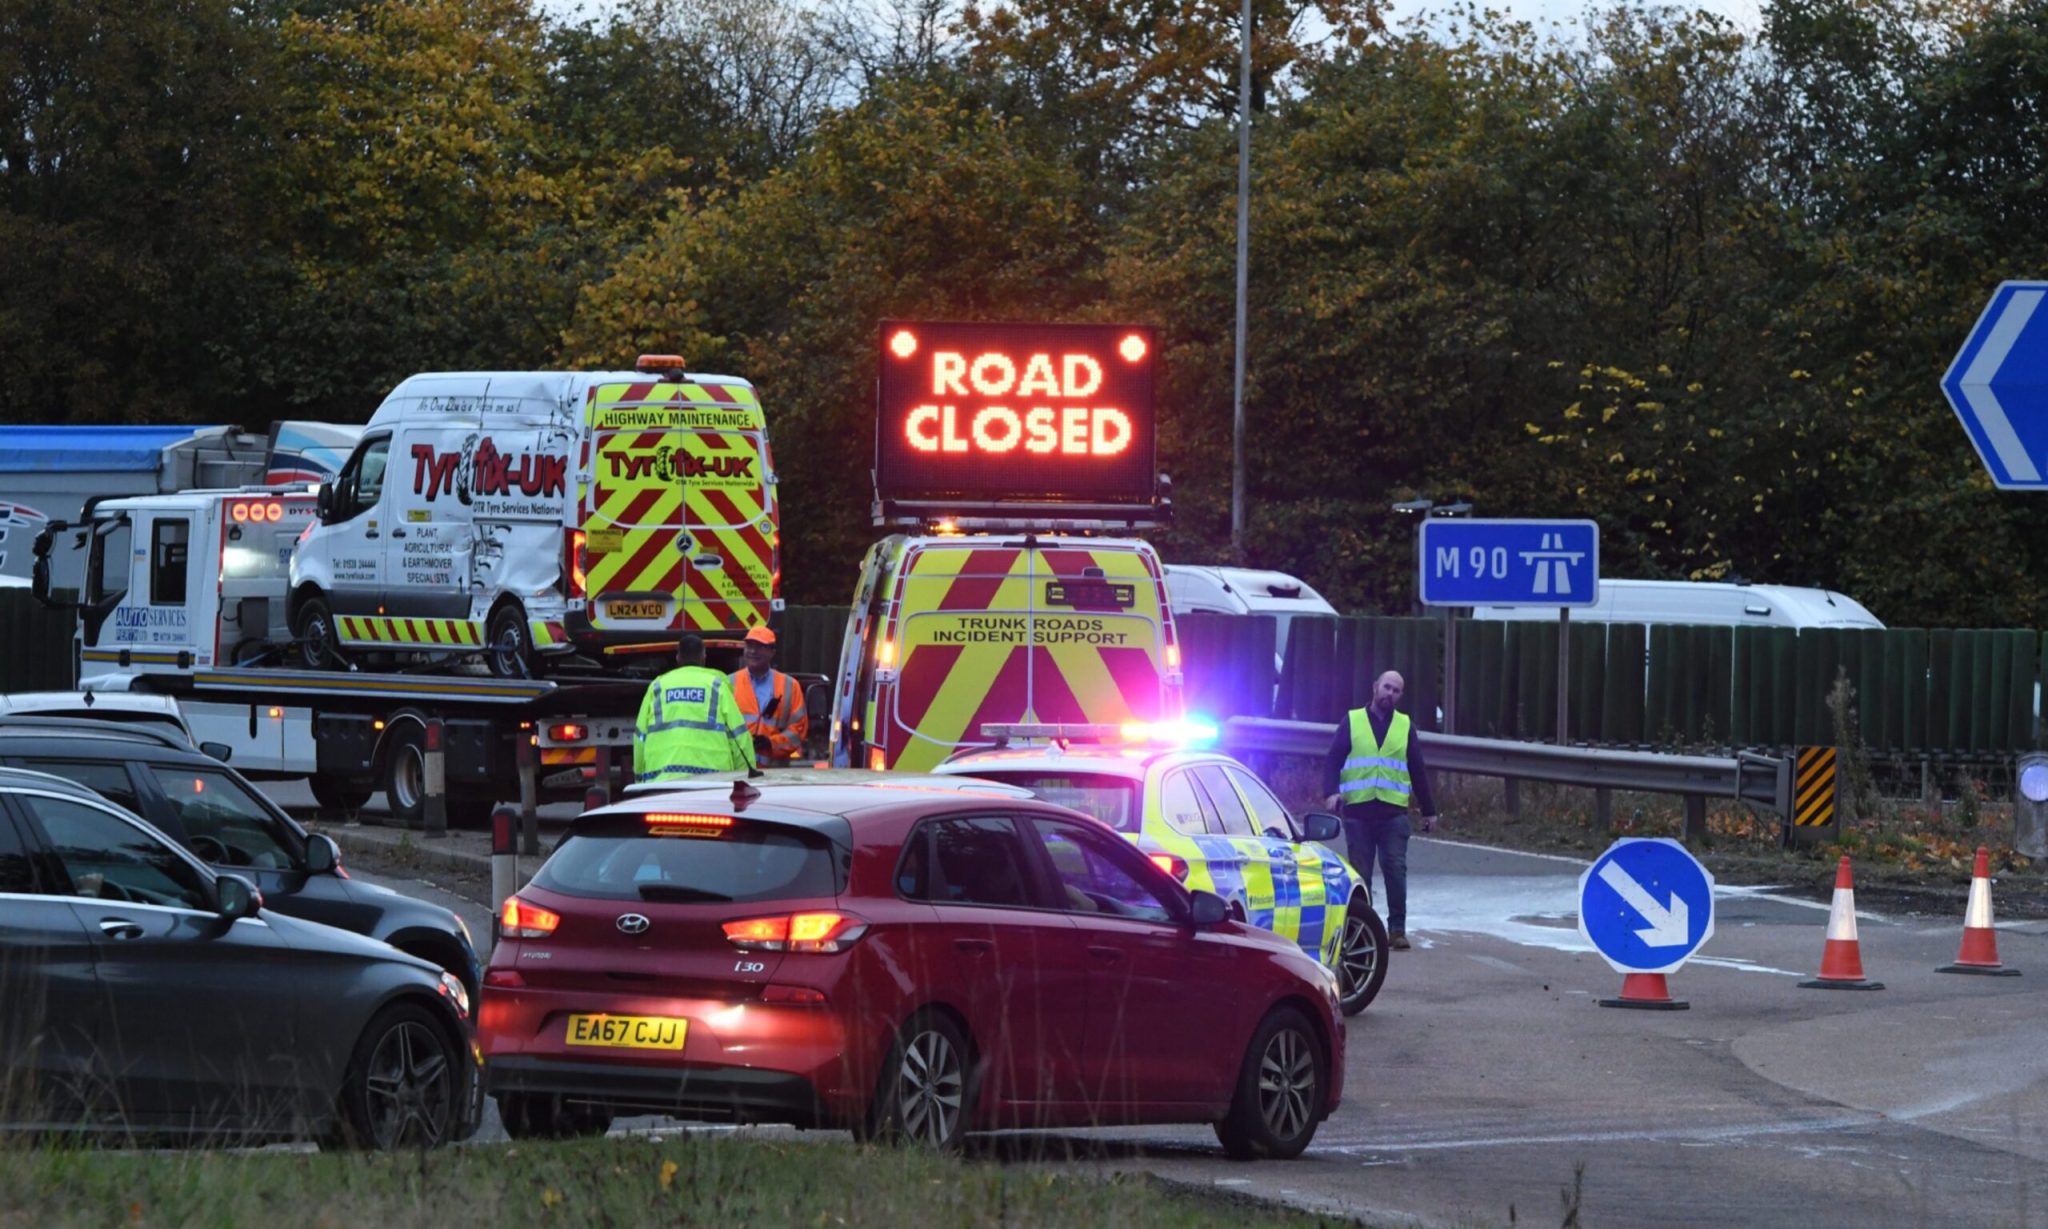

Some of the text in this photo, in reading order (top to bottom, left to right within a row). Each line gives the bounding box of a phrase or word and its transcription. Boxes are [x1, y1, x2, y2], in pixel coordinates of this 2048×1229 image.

[933, 352, 1102, 397] ROAD
[604, 412, 751, 426] HIGHWAY MAINTENANCE
[905, 405, 1132, 455] CLOSED
[487, 501, 500, 515] Tyre
[502, 502, 529, 514] Services
[408, 557, 452, 568] EARTHMOVER
[1436, 546, 1507, 579] M 90
[407, 572, 450, 584] SPECIALISTS
[116, 607, 187, 627] AUTO SERVICES
[610, 604, 637, 616] LN24
[958, 618, 1103, 631] TRUNK ROADS
[933, 630, 1128, 645] INCIDENT SUPPORT
[667, 688, 704, 702] POLICE
[575, 1018, 677, 1044] EA67 CJJ
